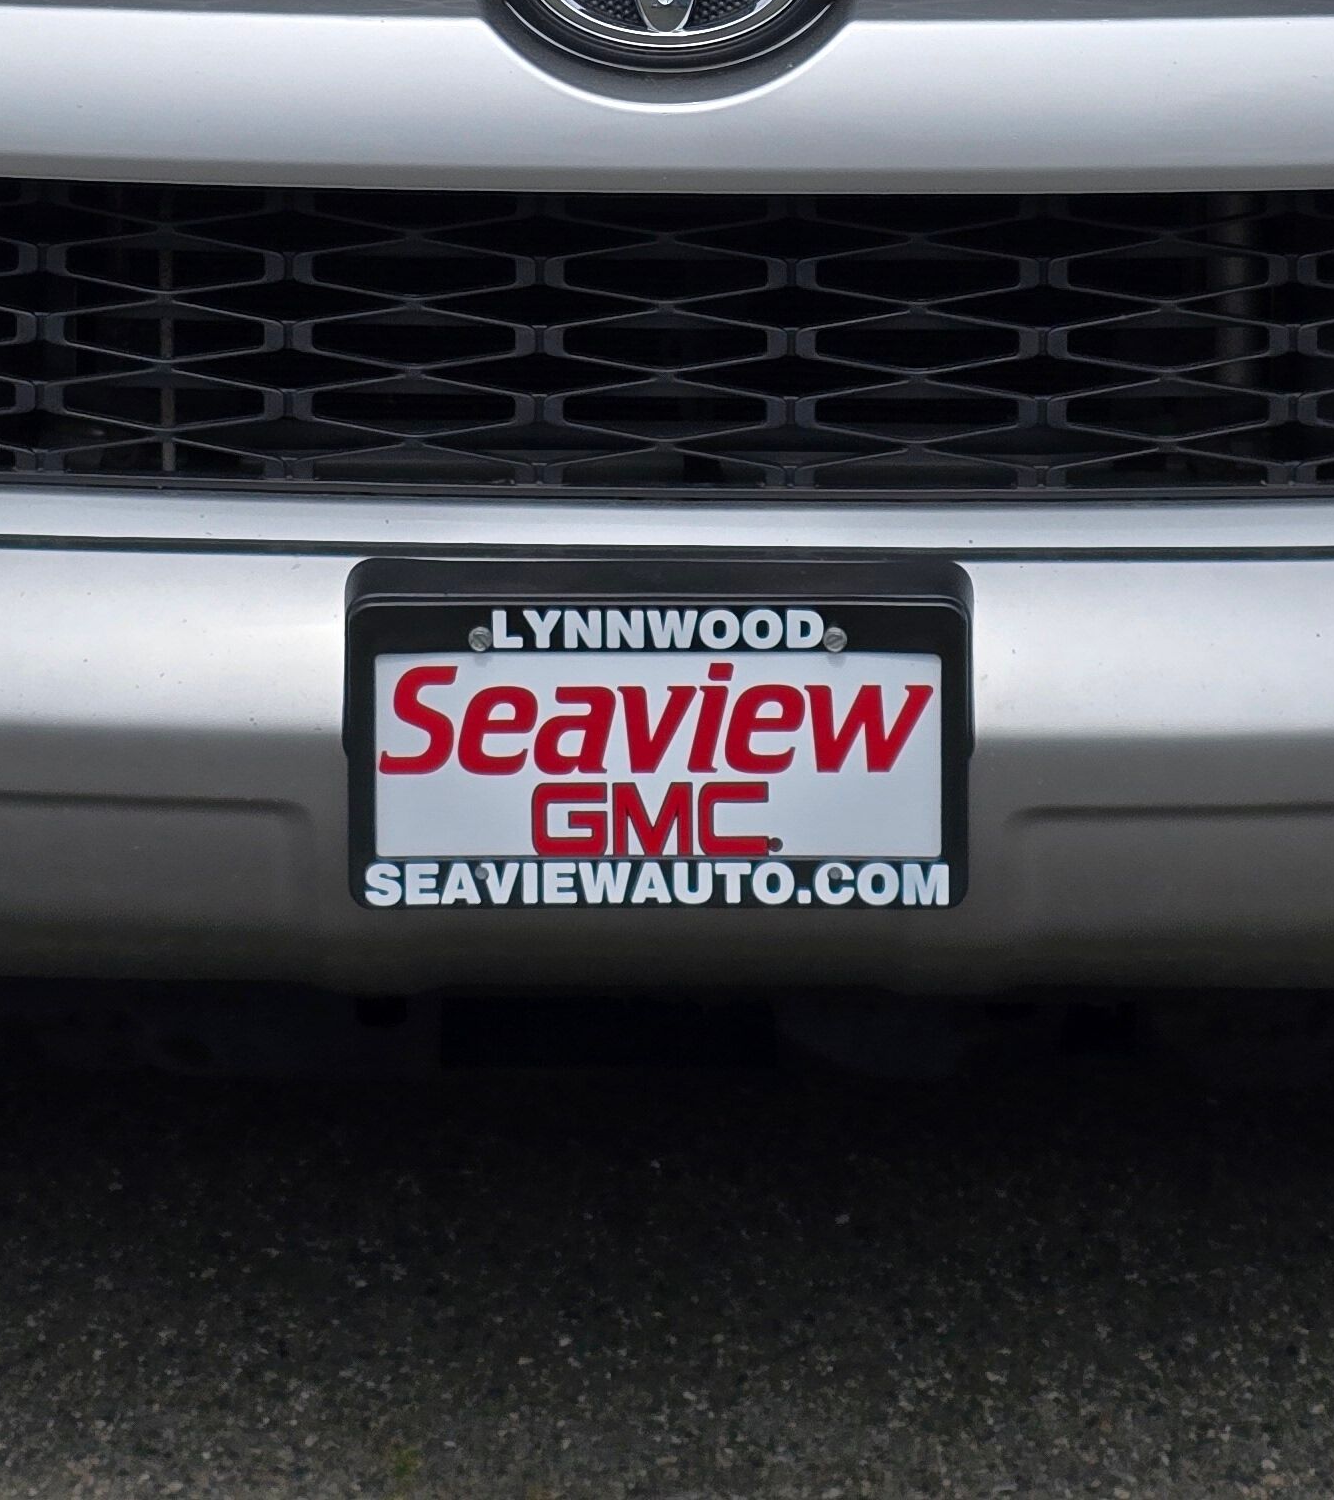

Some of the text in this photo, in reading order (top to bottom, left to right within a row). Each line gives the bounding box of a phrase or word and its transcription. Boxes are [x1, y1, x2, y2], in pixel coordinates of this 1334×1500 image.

[492, 609, 825, 650] LYNNWOOD
[378, 662, 934, 774] Seaview
[531, 781, 773, 858] GMC
[364, 860, 951, 908] SEAVIEWAUTO.COM
